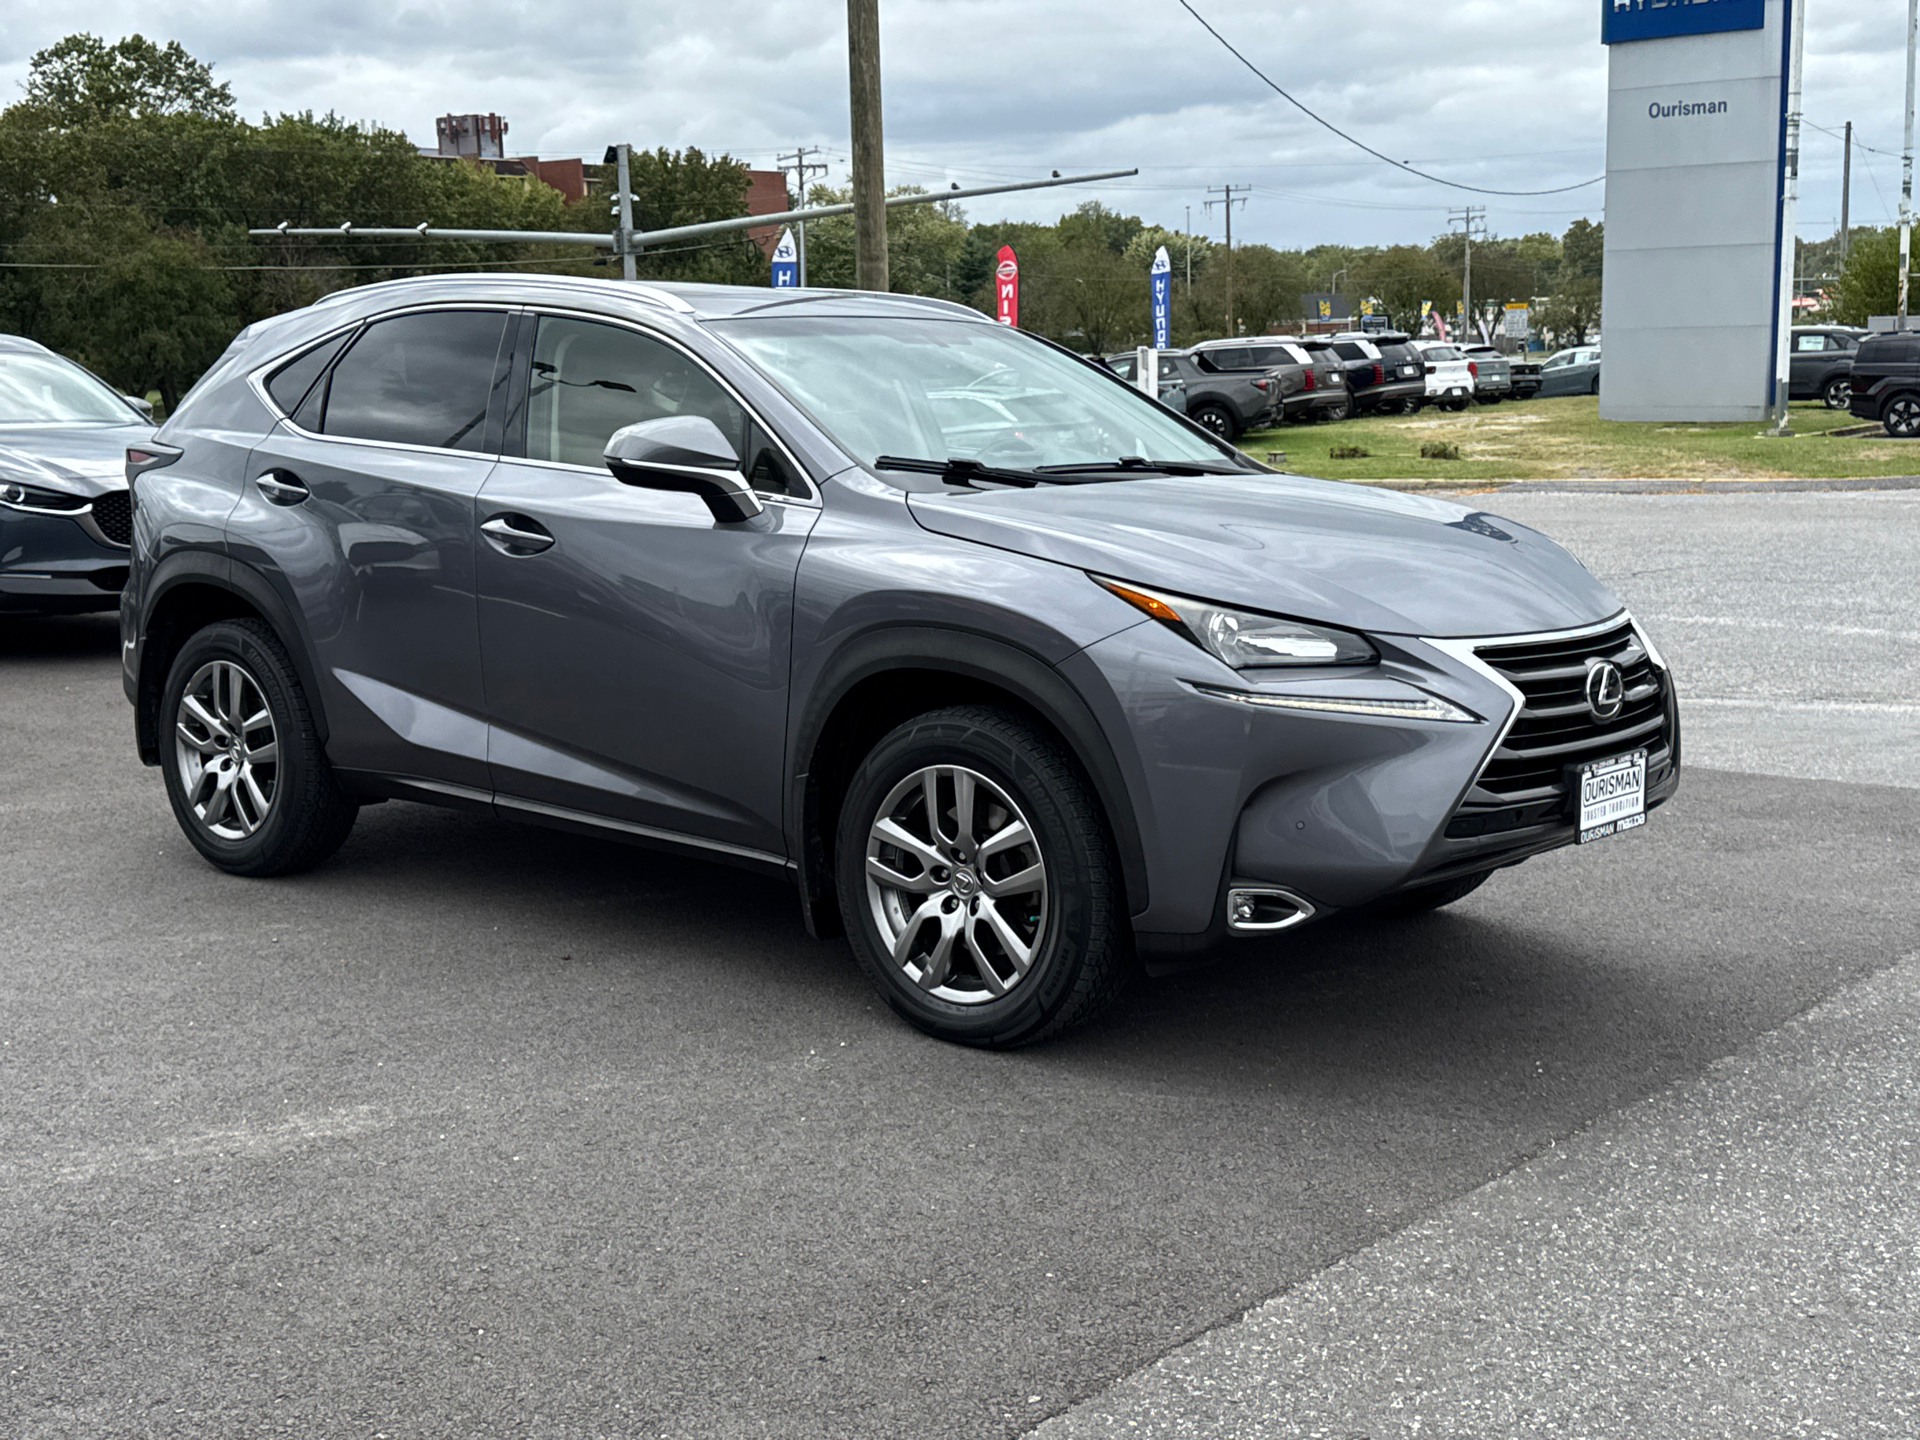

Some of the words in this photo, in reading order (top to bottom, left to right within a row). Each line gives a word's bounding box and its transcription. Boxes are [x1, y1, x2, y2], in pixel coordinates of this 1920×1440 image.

[1648, 100, 1727, 119] Ourisman
[1585, 770, 1639, 802] OURISMAN
[1584, 805, 1606, 822] TRUSTED
